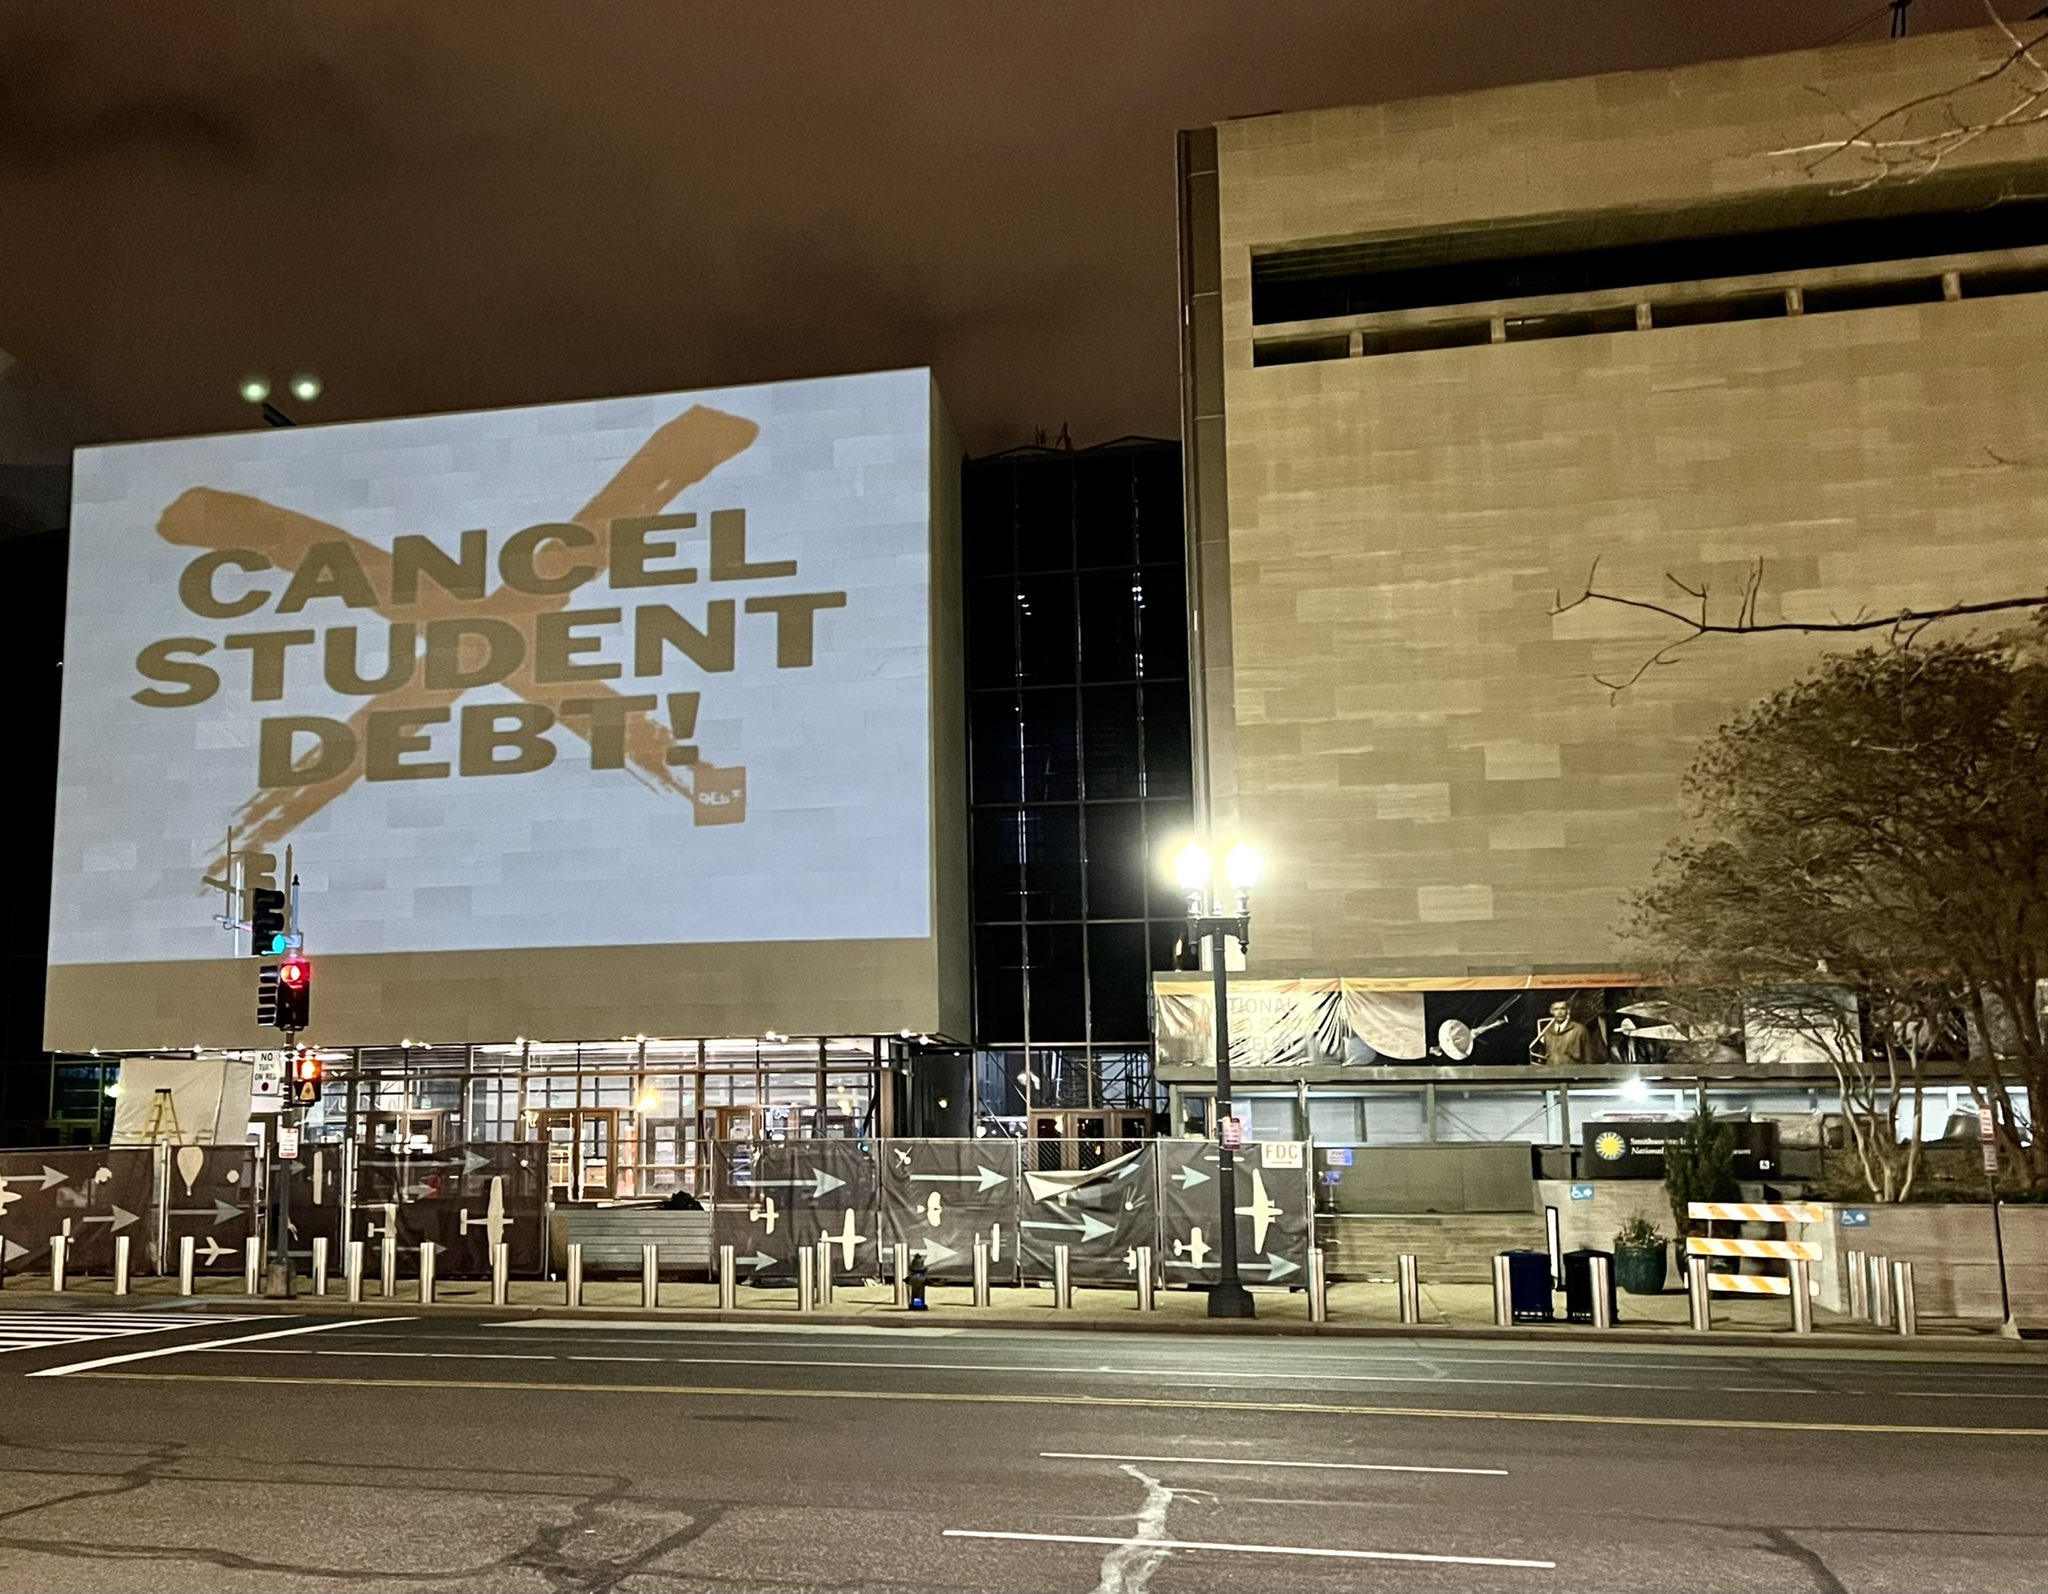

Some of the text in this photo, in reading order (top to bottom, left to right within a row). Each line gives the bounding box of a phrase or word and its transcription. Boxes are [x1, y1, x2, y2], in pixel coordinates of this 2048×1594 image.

[178, 508, 797, 619] CANCEL
[131, 591, 847, 708] STUDENT
[258, 691, 701, 789] DEBT!
[261, 1052, 274, 1062] NO
[1265, 1144, 1299, 1160] FDC
